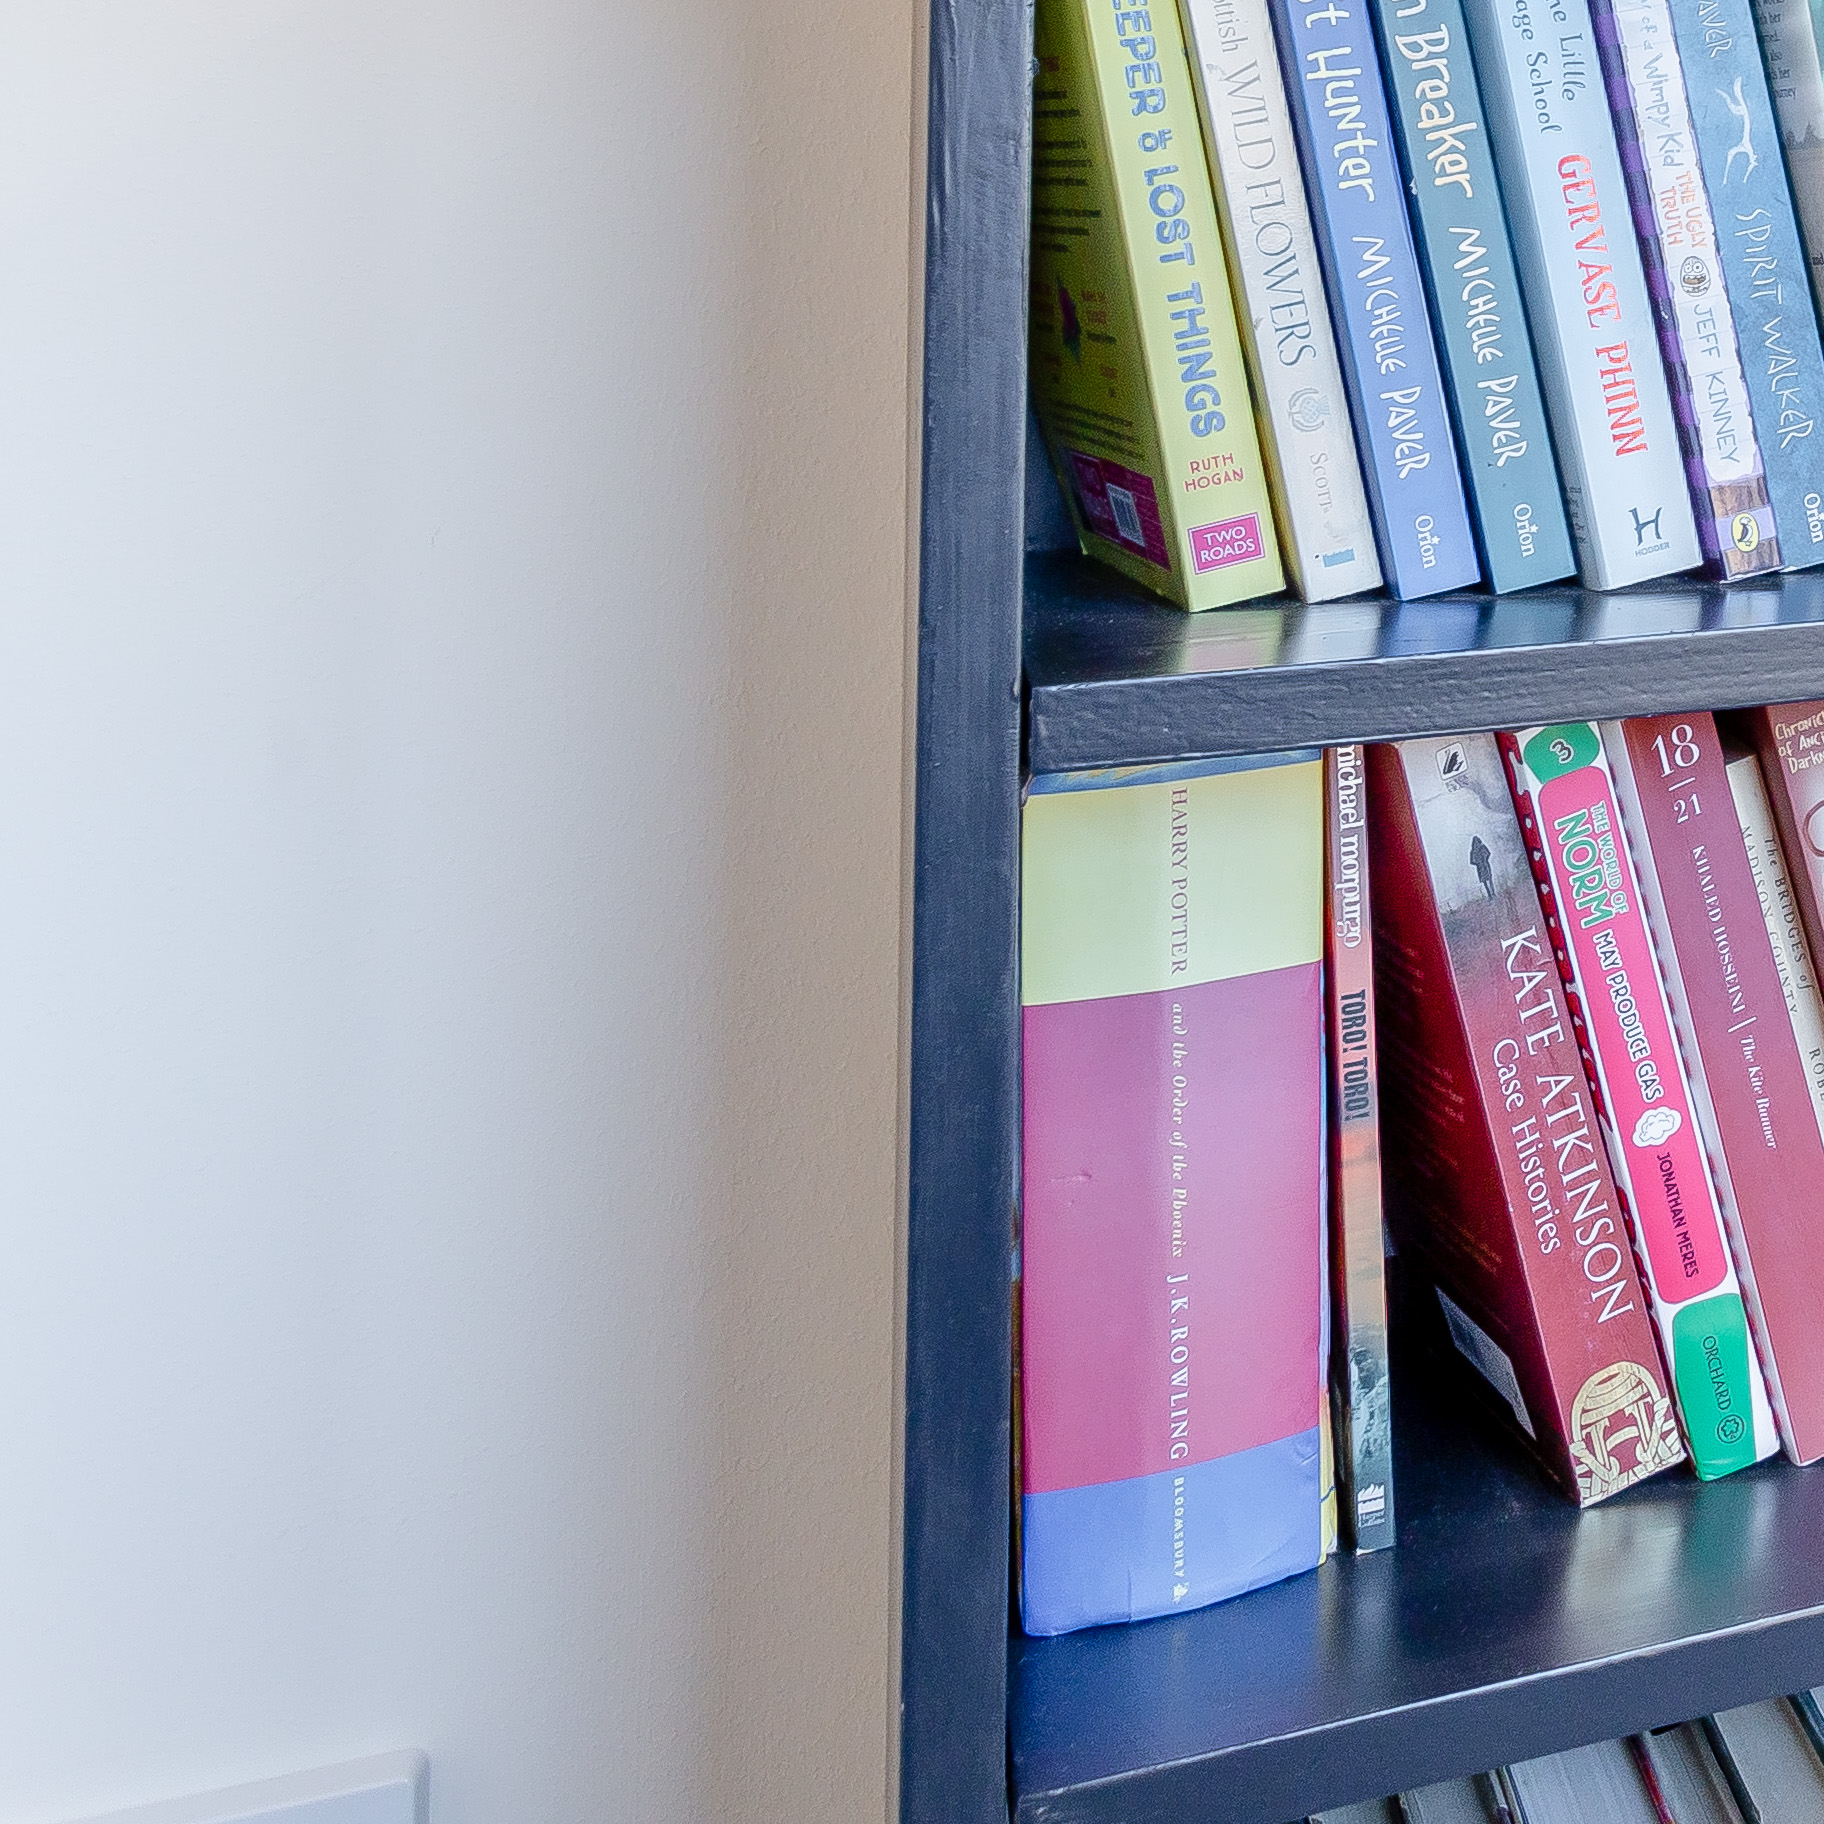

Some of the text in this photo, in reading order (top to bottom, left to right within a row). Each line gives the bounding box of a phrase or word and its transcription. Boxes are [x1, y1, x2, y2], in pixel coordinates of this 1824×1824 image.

[1394, 23, 1478, 200] Breaker
[1526, 51, 1563, 135] School
[1560, 32, 1587, 102] Little
[1138, 129, 1173, 152] OF
[1675, 170, 1693, 202] THE
[1143, 164, 1195, 266] LOST
[1223, 58, 1318, 368] WILD FLOWERS
[1448, 226, 1529, 468] MICHELLE PAVER
[1556, 153, 1650, 459] GERVASE PHINN
[1734, 206, 1815, 451] SPIRIT WALKER
[1167, 281, 1226, 438] THINGS
[1352, 234, 1432, 481] MICHELLE PAVER
[1693, 303, 1741, 465] JEFF KINNEY
[1184, 466, 1244, 493] HOGAN
[1190, 452, 1235, 475] RUTH
[1200, 537, 1256, 563] ROADS
[1203, 524, 1247, 546] TWO
[1414, 513, 1442, 570] Orion
[1513, 502, 1540, 558] Orion
[1634, 540, 1672, 558] HODDER
[1548, 738, 1575, 765] 3
[1650, 723, 1701, 779] 18
[1778, 742, 1793, 760] of
[1590, 800, 1627, 916] THE WORLD OF
[1672, 792, 1702, 825] 21
[1763, 836, 1779, 868] The
[1335, 833, 1364, 949] morpurgo
[1553, 810, 1615, 930] NORM
[1169, 786, 1189, 1259] HARRY POTTER and the Order of the Phoenix
[1340, 988, 1371, 1122] TORO! TORO!
[1592, 930, 1665, 1104] MAY PRODUCE GAS
[1500, 925, 1635, 1324] KATE ATKINSON
[1738, 1033, 1779, 1151] The Kite Runner
[1491, 1036, 1562, 1256] Case Histories
[1656, 1152, 1699, 1279] JONATHAN MERES
[1702, 1334, 1733, 1412] ORCHARD
[1173, 1476, 1186, 1578] BLOOMSBURY
